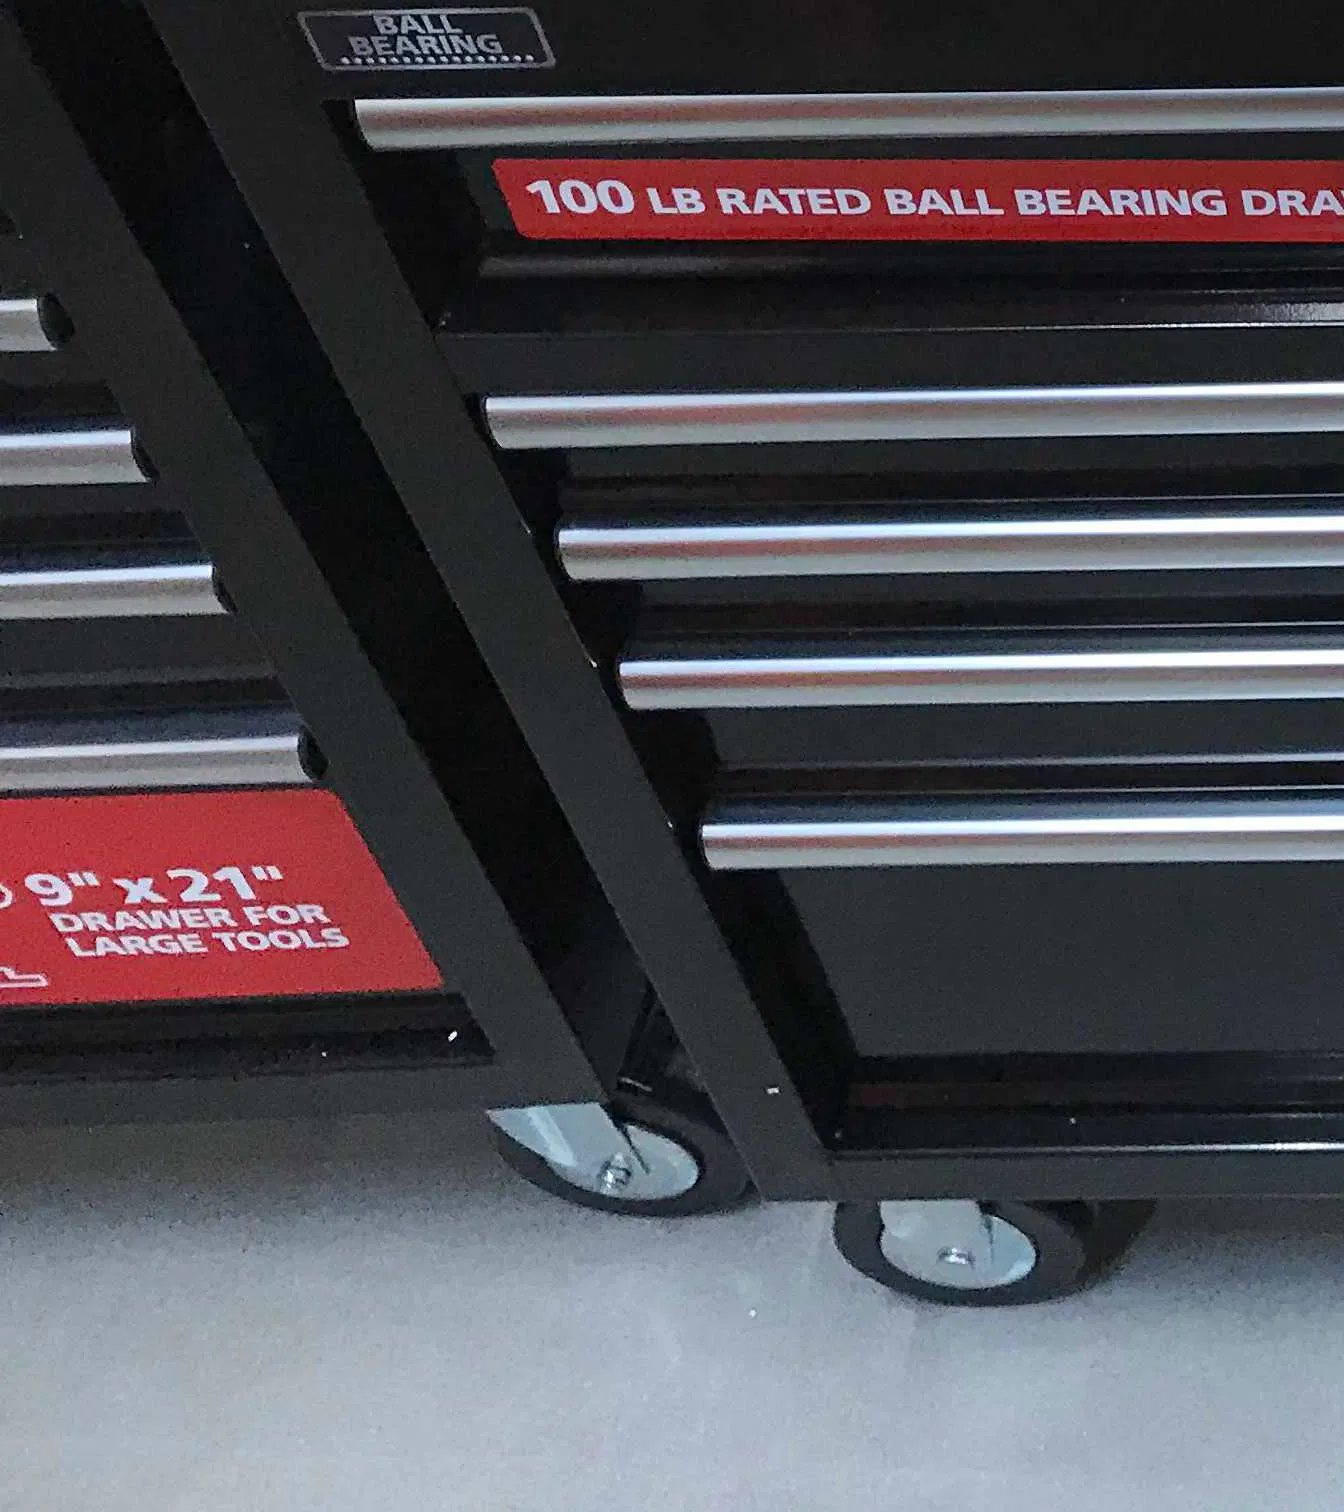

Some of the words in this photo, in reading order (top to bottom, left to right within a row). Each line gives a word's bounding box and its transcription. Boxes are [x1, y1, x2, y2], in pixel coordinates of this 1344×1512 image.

[373, 14, 463, 34] BALL
[349, 34, 502, 56] BEARING
[526, 179, 635, 215] 100
[646, 188, 706, 215] LB
[716, 187, 872, 216] RATED
[883, 188, 1004, 216] BALL
[1014, 189, 1226, 216] BEARING
[49, 907, 238, 933] DRAWER
[245, 904, 331, 926] FOR
[66, 934, 208, 957] LARGE
[213, 928, 350, 952] TOOLS
